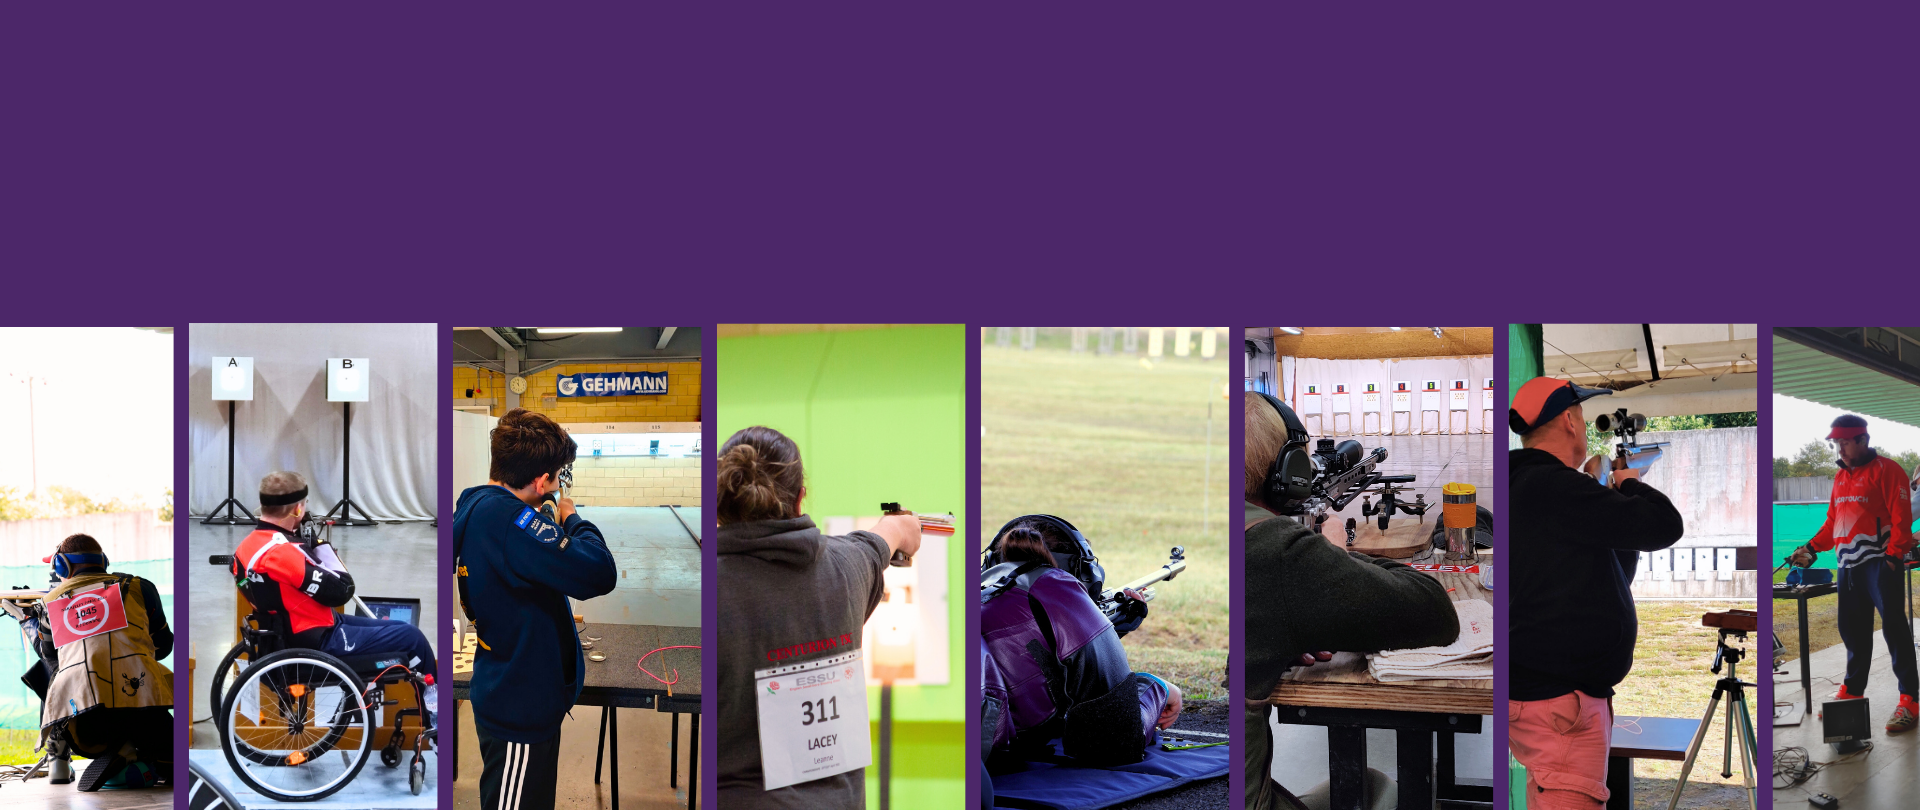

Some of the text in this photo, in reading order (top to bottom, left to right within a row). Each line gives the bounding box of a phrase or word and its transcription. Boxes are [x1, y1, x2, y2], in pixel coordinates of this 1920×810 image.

[228, 357, 238, 367] A
[342, 359, 353, 369] B
[582, 376, 667, 392] GEHMANN
[75, 606, 97, 619] 1045
[767, 638, 837, 661] CENTURION
[796, 671, 835, 686] ESSU
[801, 695, 840, 726] 311
[808, 733, 838, 751] LACEY
